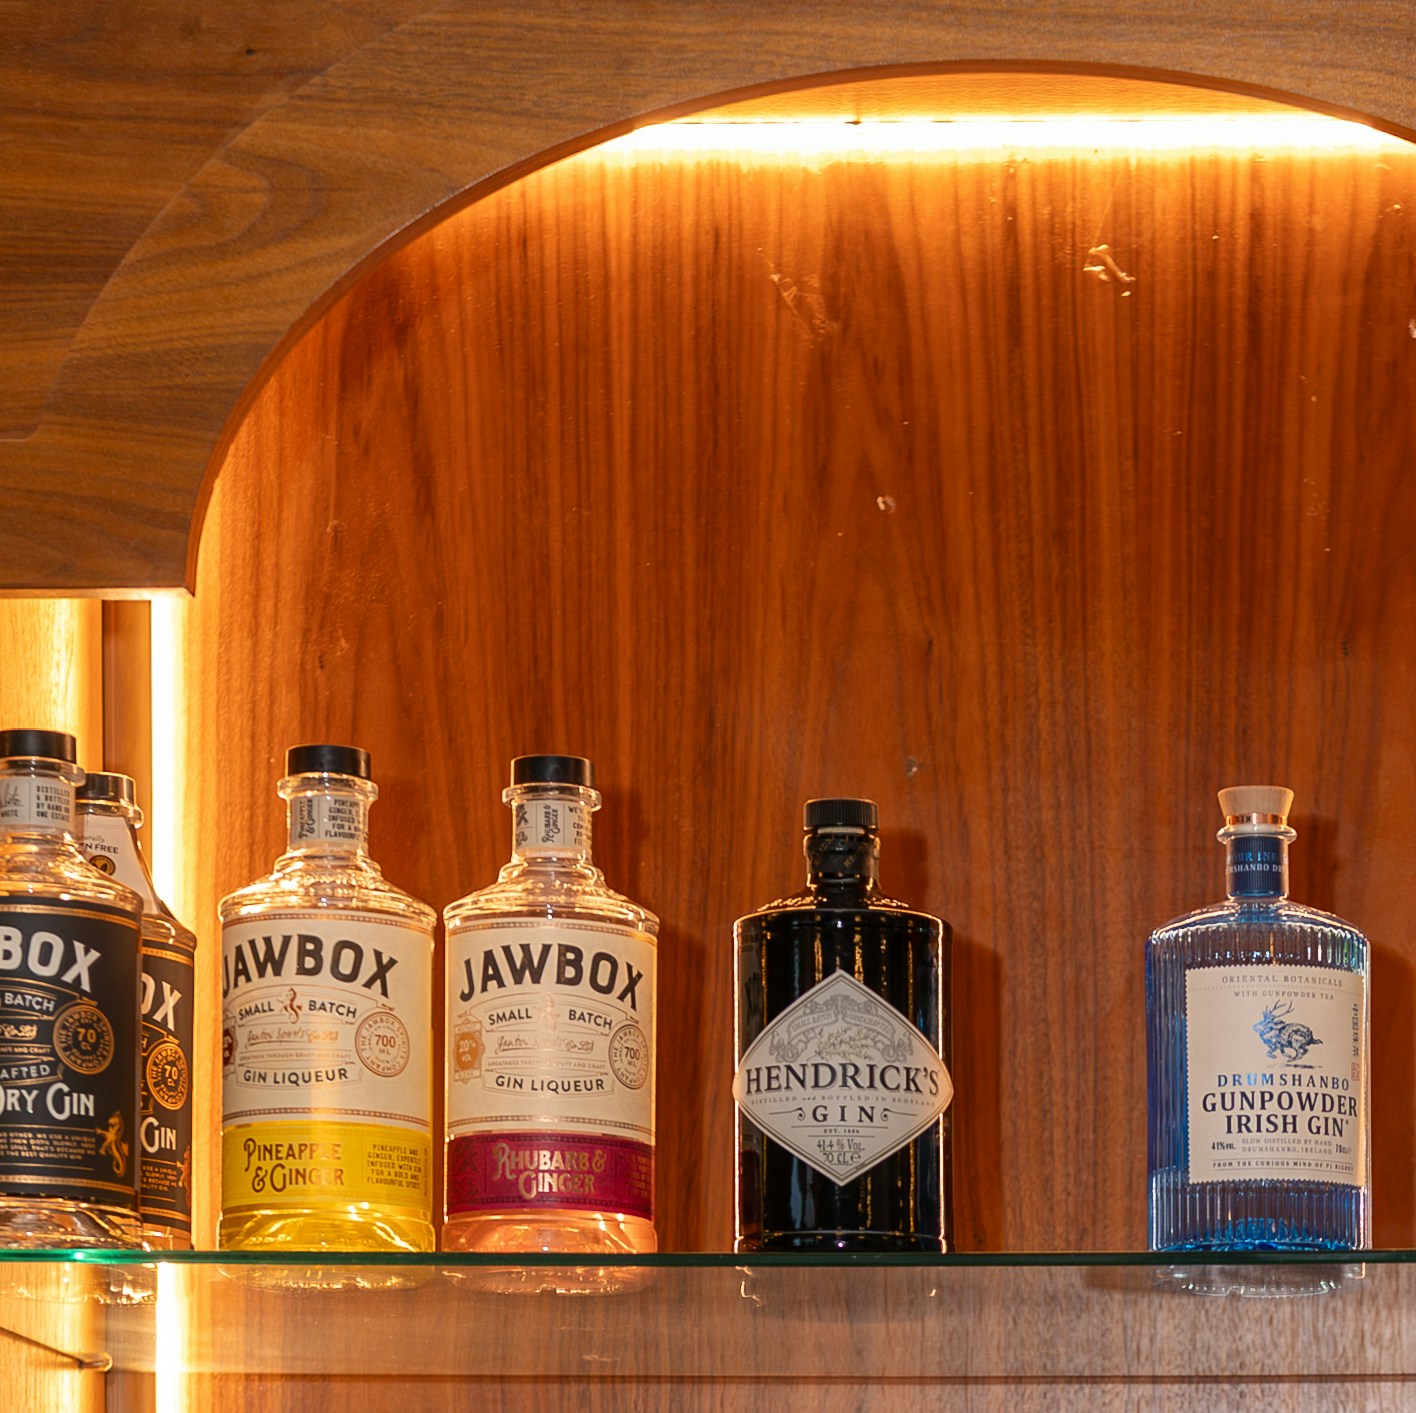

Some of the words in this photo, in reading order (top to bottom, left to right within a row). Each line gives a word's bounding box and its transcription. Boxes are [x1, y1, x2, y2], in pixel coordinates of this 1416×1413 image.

[95, 843, 119, 854] FREE
[222, 933, 398, 1000] JAWBOX
[459, 943, 643, 1012] JAWBOX
[1221, 975, 1278, 984] ORIENTAL
[1283, 975, 1342, 988] BOTANICALS
[4, 992, 55, 1012] BATCH
[1233, 990, 1258, 998] WITH
[1262, 990, 1316, 999] GUNPOWDER
[1320, 992, 1334, 1000] TEA
[239, 1001, 274, 1021] SMALL
[308, 1000, 357, 1019] BATCH
[489, 1007, 532, 1026] SMALL
[569, 1009, 612, 1030] BATCH
[77, 1028, 96, 1041] 70
[375, 1034, 396, 1048] 700
[624, 1046, 641, 1061] 700
[243, 1069, 267, 1083] GIN
[273, 1067, 348, 1087] LIQUEUR
[496, 1075, 524, 1090] GIN
[531, 1078, 605, 1094] LIQUEUR
[746, 1062, 940, 1097] HENDRICK'S
[1217, 1072, 1349, 1092] DRUMSHANBO
[46, 1082, 95, 1121] GIN
[751, 1096, 797, 1106] DISTILLED
[1202, 1090, 1358, 1118] GUNPOWDER
[812, 1104, 875, 1123] GIN
[1225, 1113, 1298, 1134] IRISH
[140, 1116, 177, 1153] GIN
[243, 1138, 342, 1172] PINEAPPLE
[823, 1152, 834, 1164] 70
[1301, 1147, 1332, 1155] IRELAND
[493, 1142, 588, 1181] RHUBARB
[518, 1171, 596, 1200] GINGER
